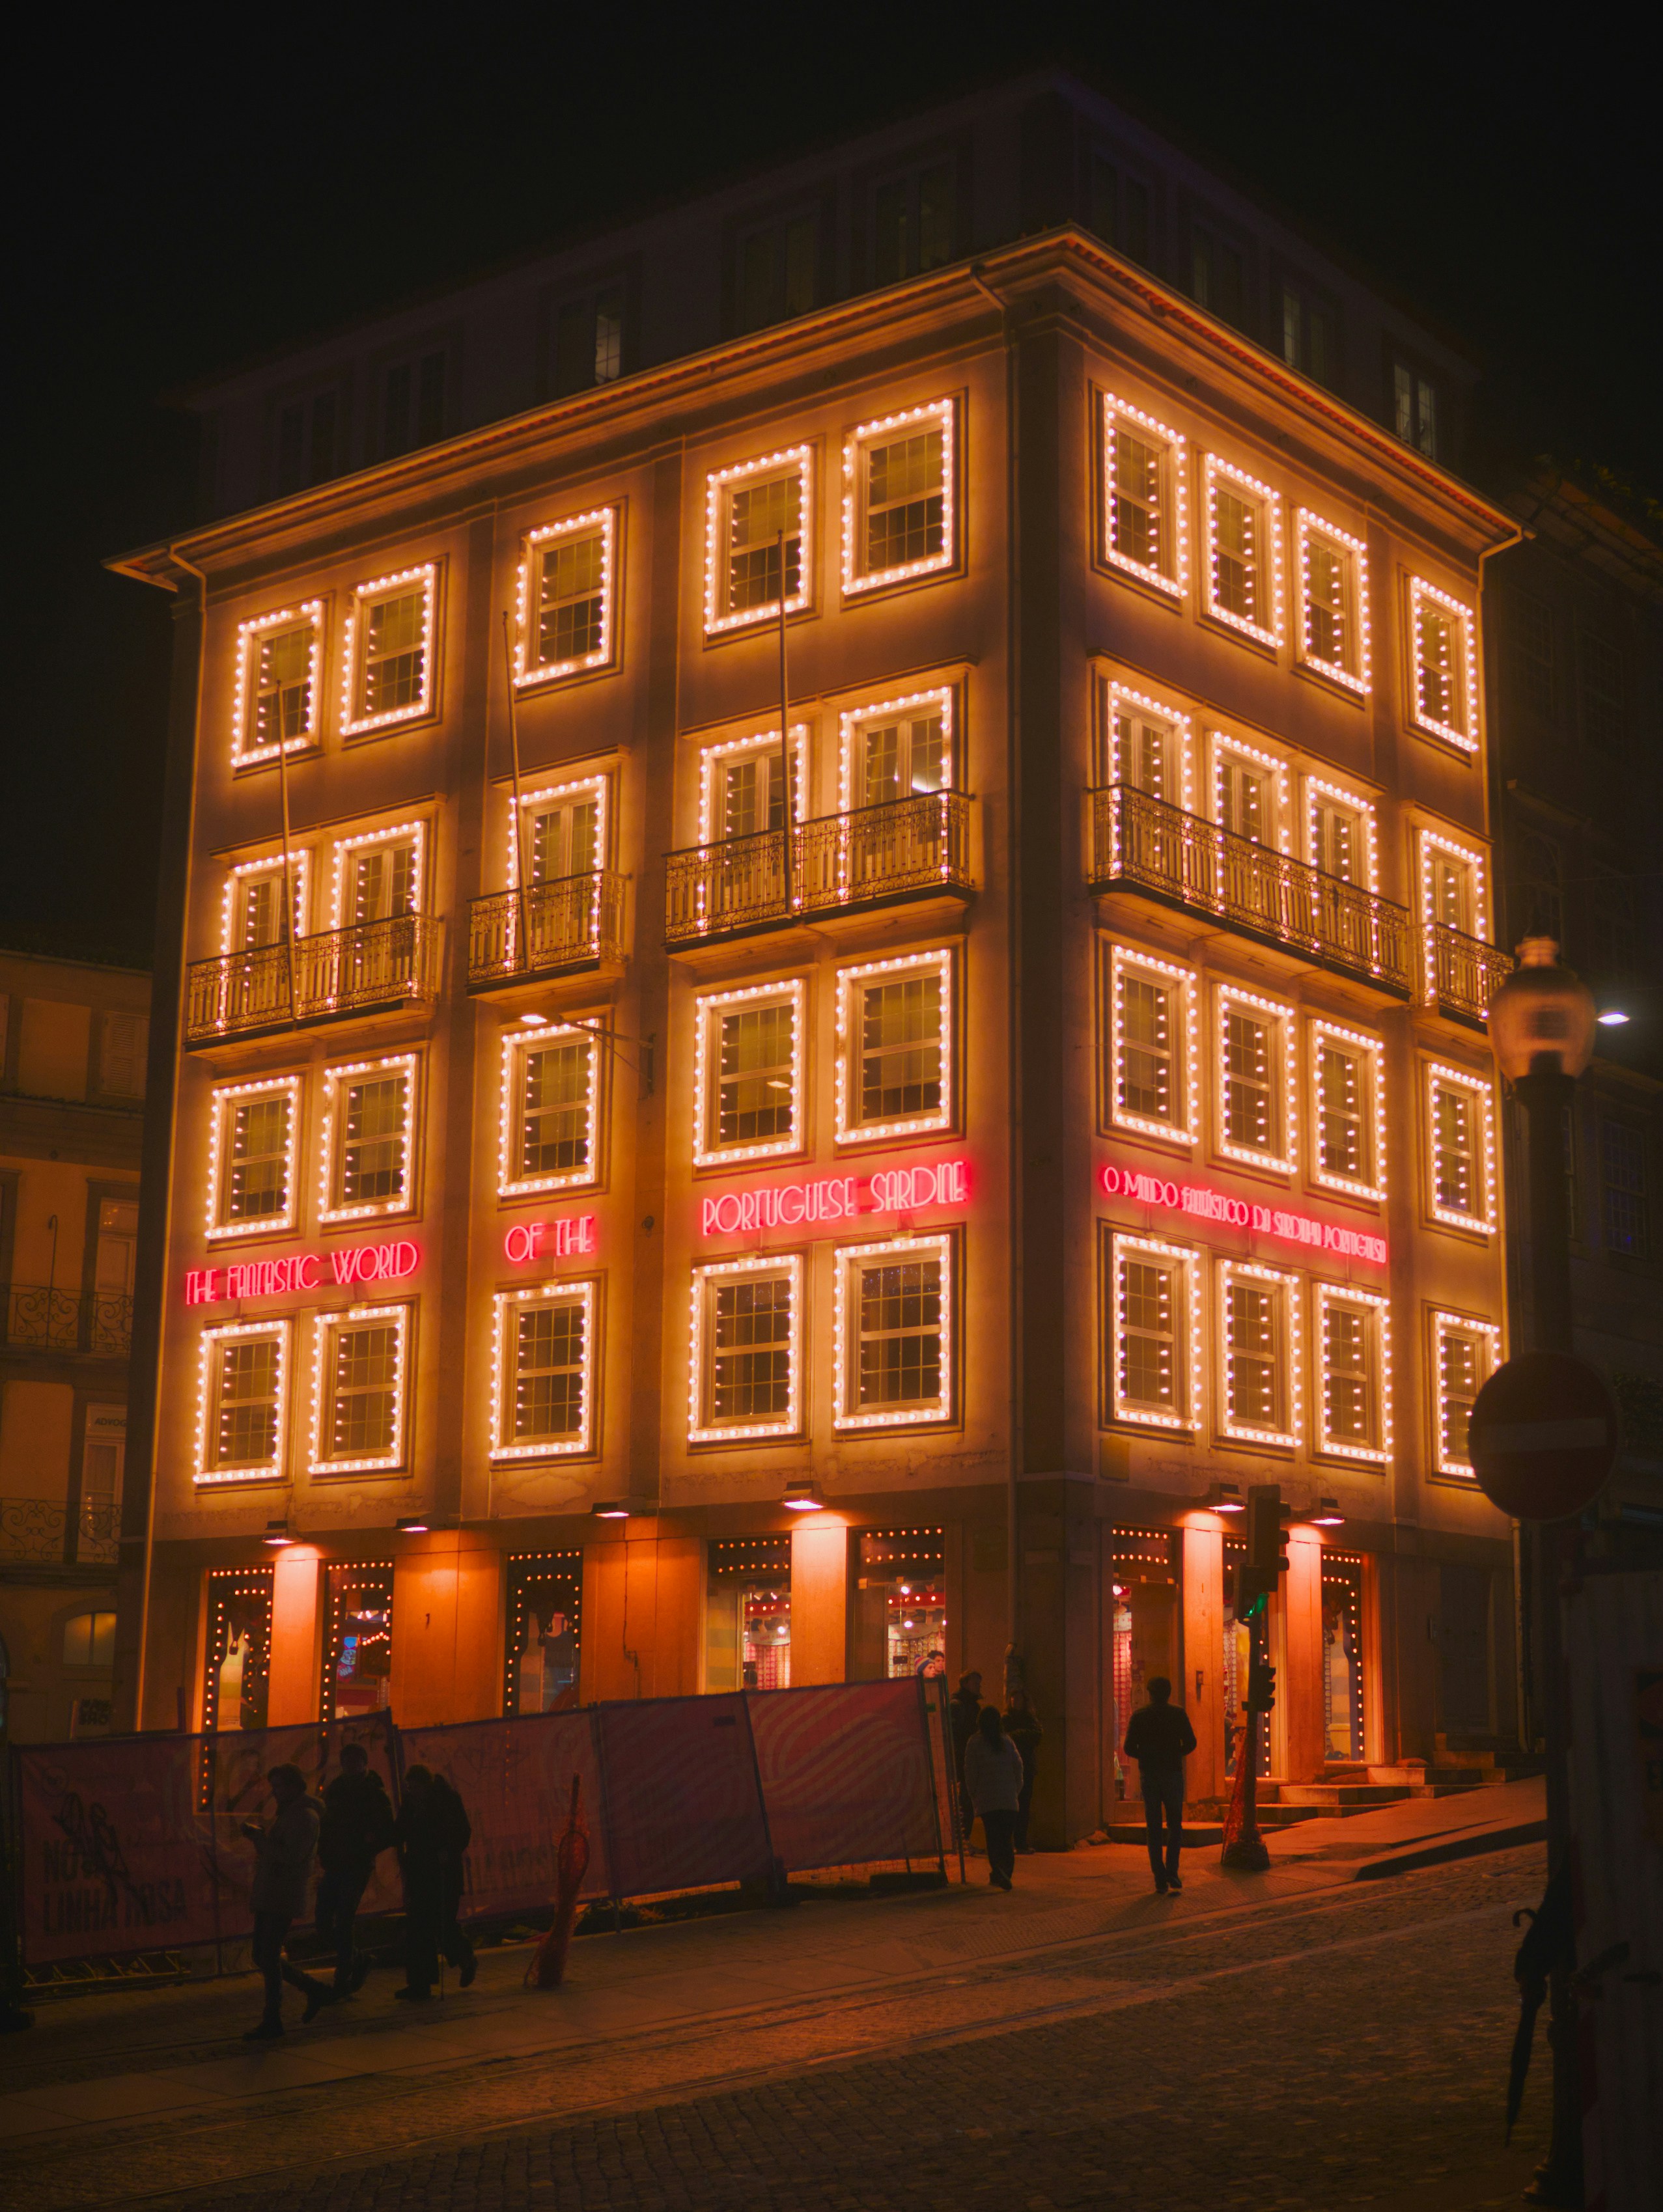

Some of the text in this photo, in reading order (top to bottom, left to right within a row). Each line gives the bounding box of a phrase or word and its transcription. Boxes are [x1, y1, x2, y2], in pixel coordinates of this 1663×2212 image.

[703, 1161, 965, 1236] PORTUGUESE SARDINE
[1104, 1166, 1120, 1193] O
[1123, 1170, 1179, 1208] MUNDO
[1252, 1204, 1271, 1233] DA
[1273, 1211, 1322, 1246] SARDINHA
[1323, 1224, 1386, 1264] PORTUGUESA
[186, 1241, 419, 1305] THE FANTASTIC WORLD
[504, 1215, 595, 1262] OF THE
